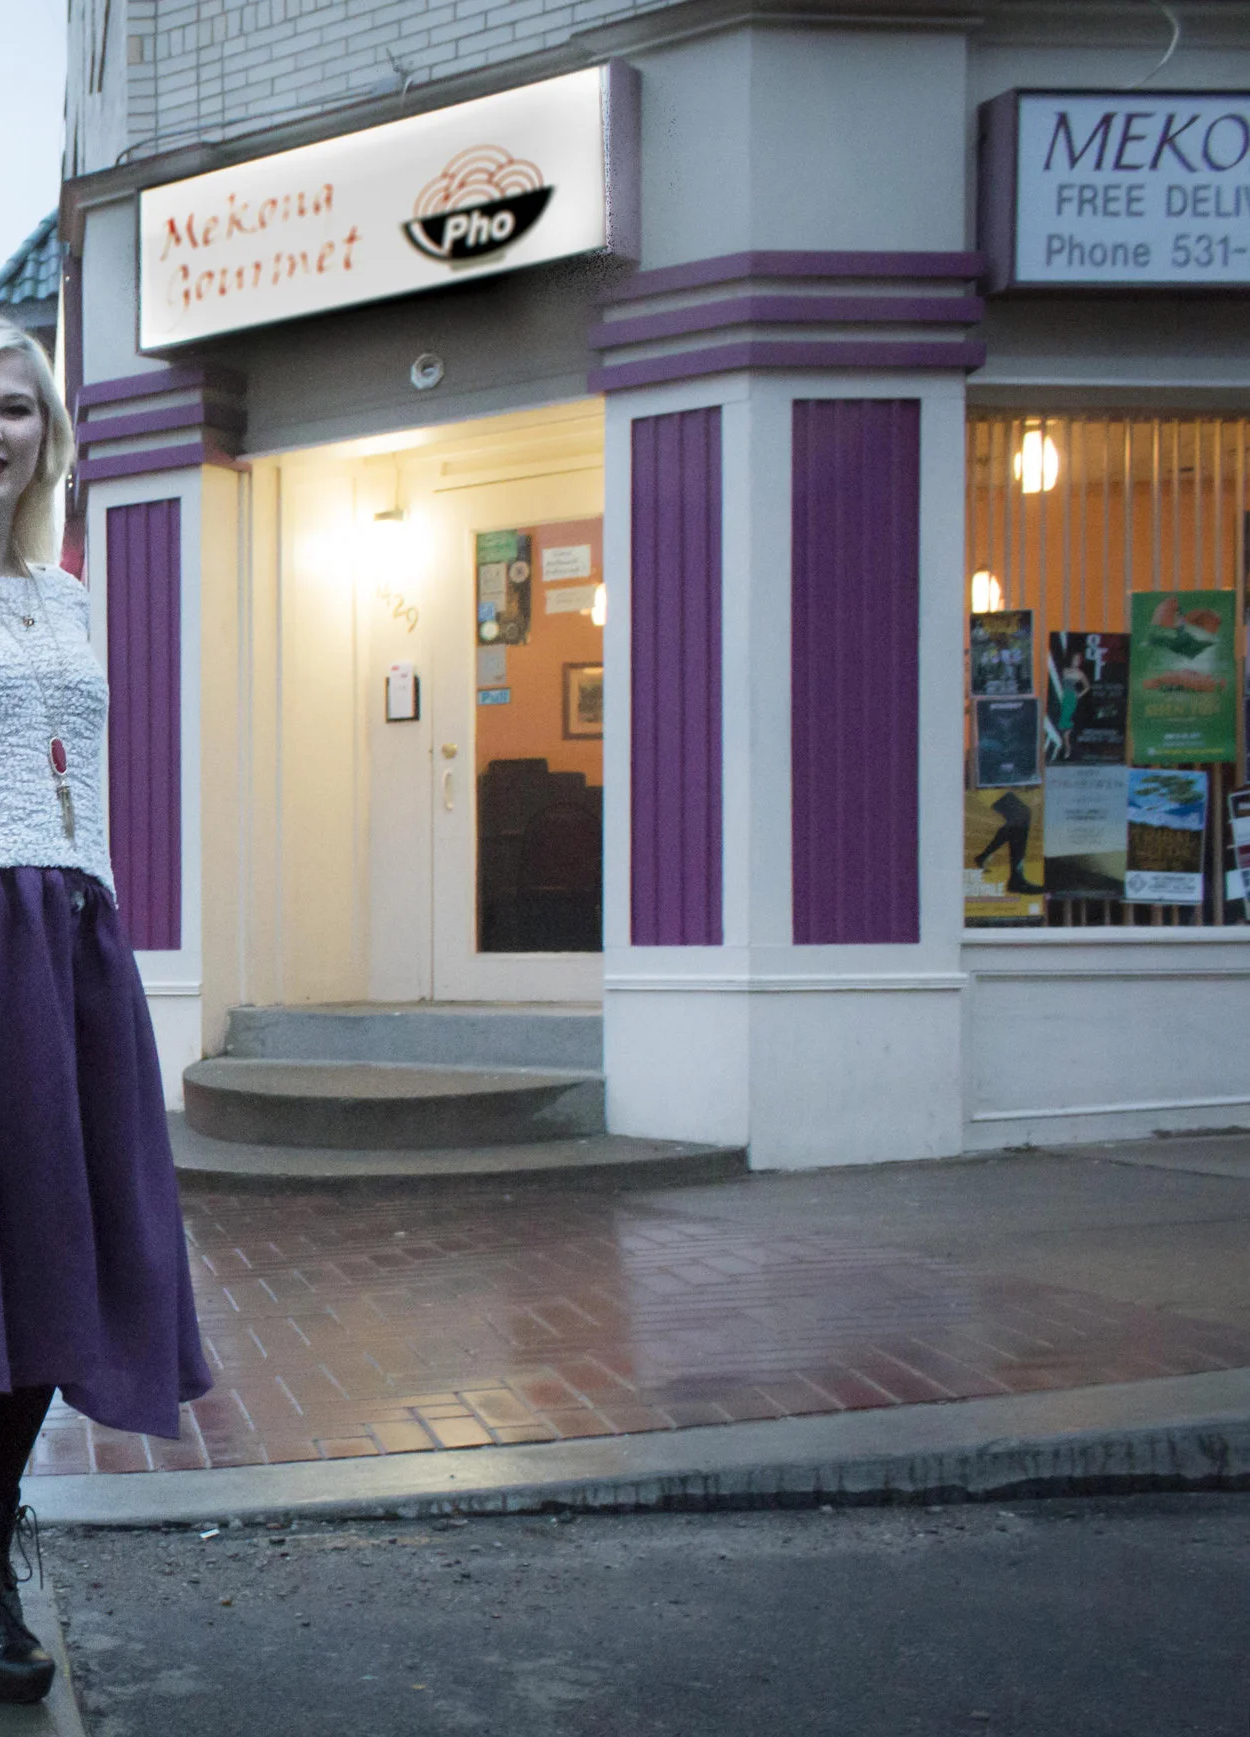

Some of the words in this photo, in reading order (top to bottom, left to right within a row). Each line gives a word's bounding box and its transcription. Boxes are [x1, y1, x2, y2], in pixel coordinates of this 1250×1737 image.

[1055, 183, 1147, 218] FREE
[441, 209, 517, 252] Pho
[1044, 232, 1152, 268] Phone
[165, 225, 364, 316] Gourmet
